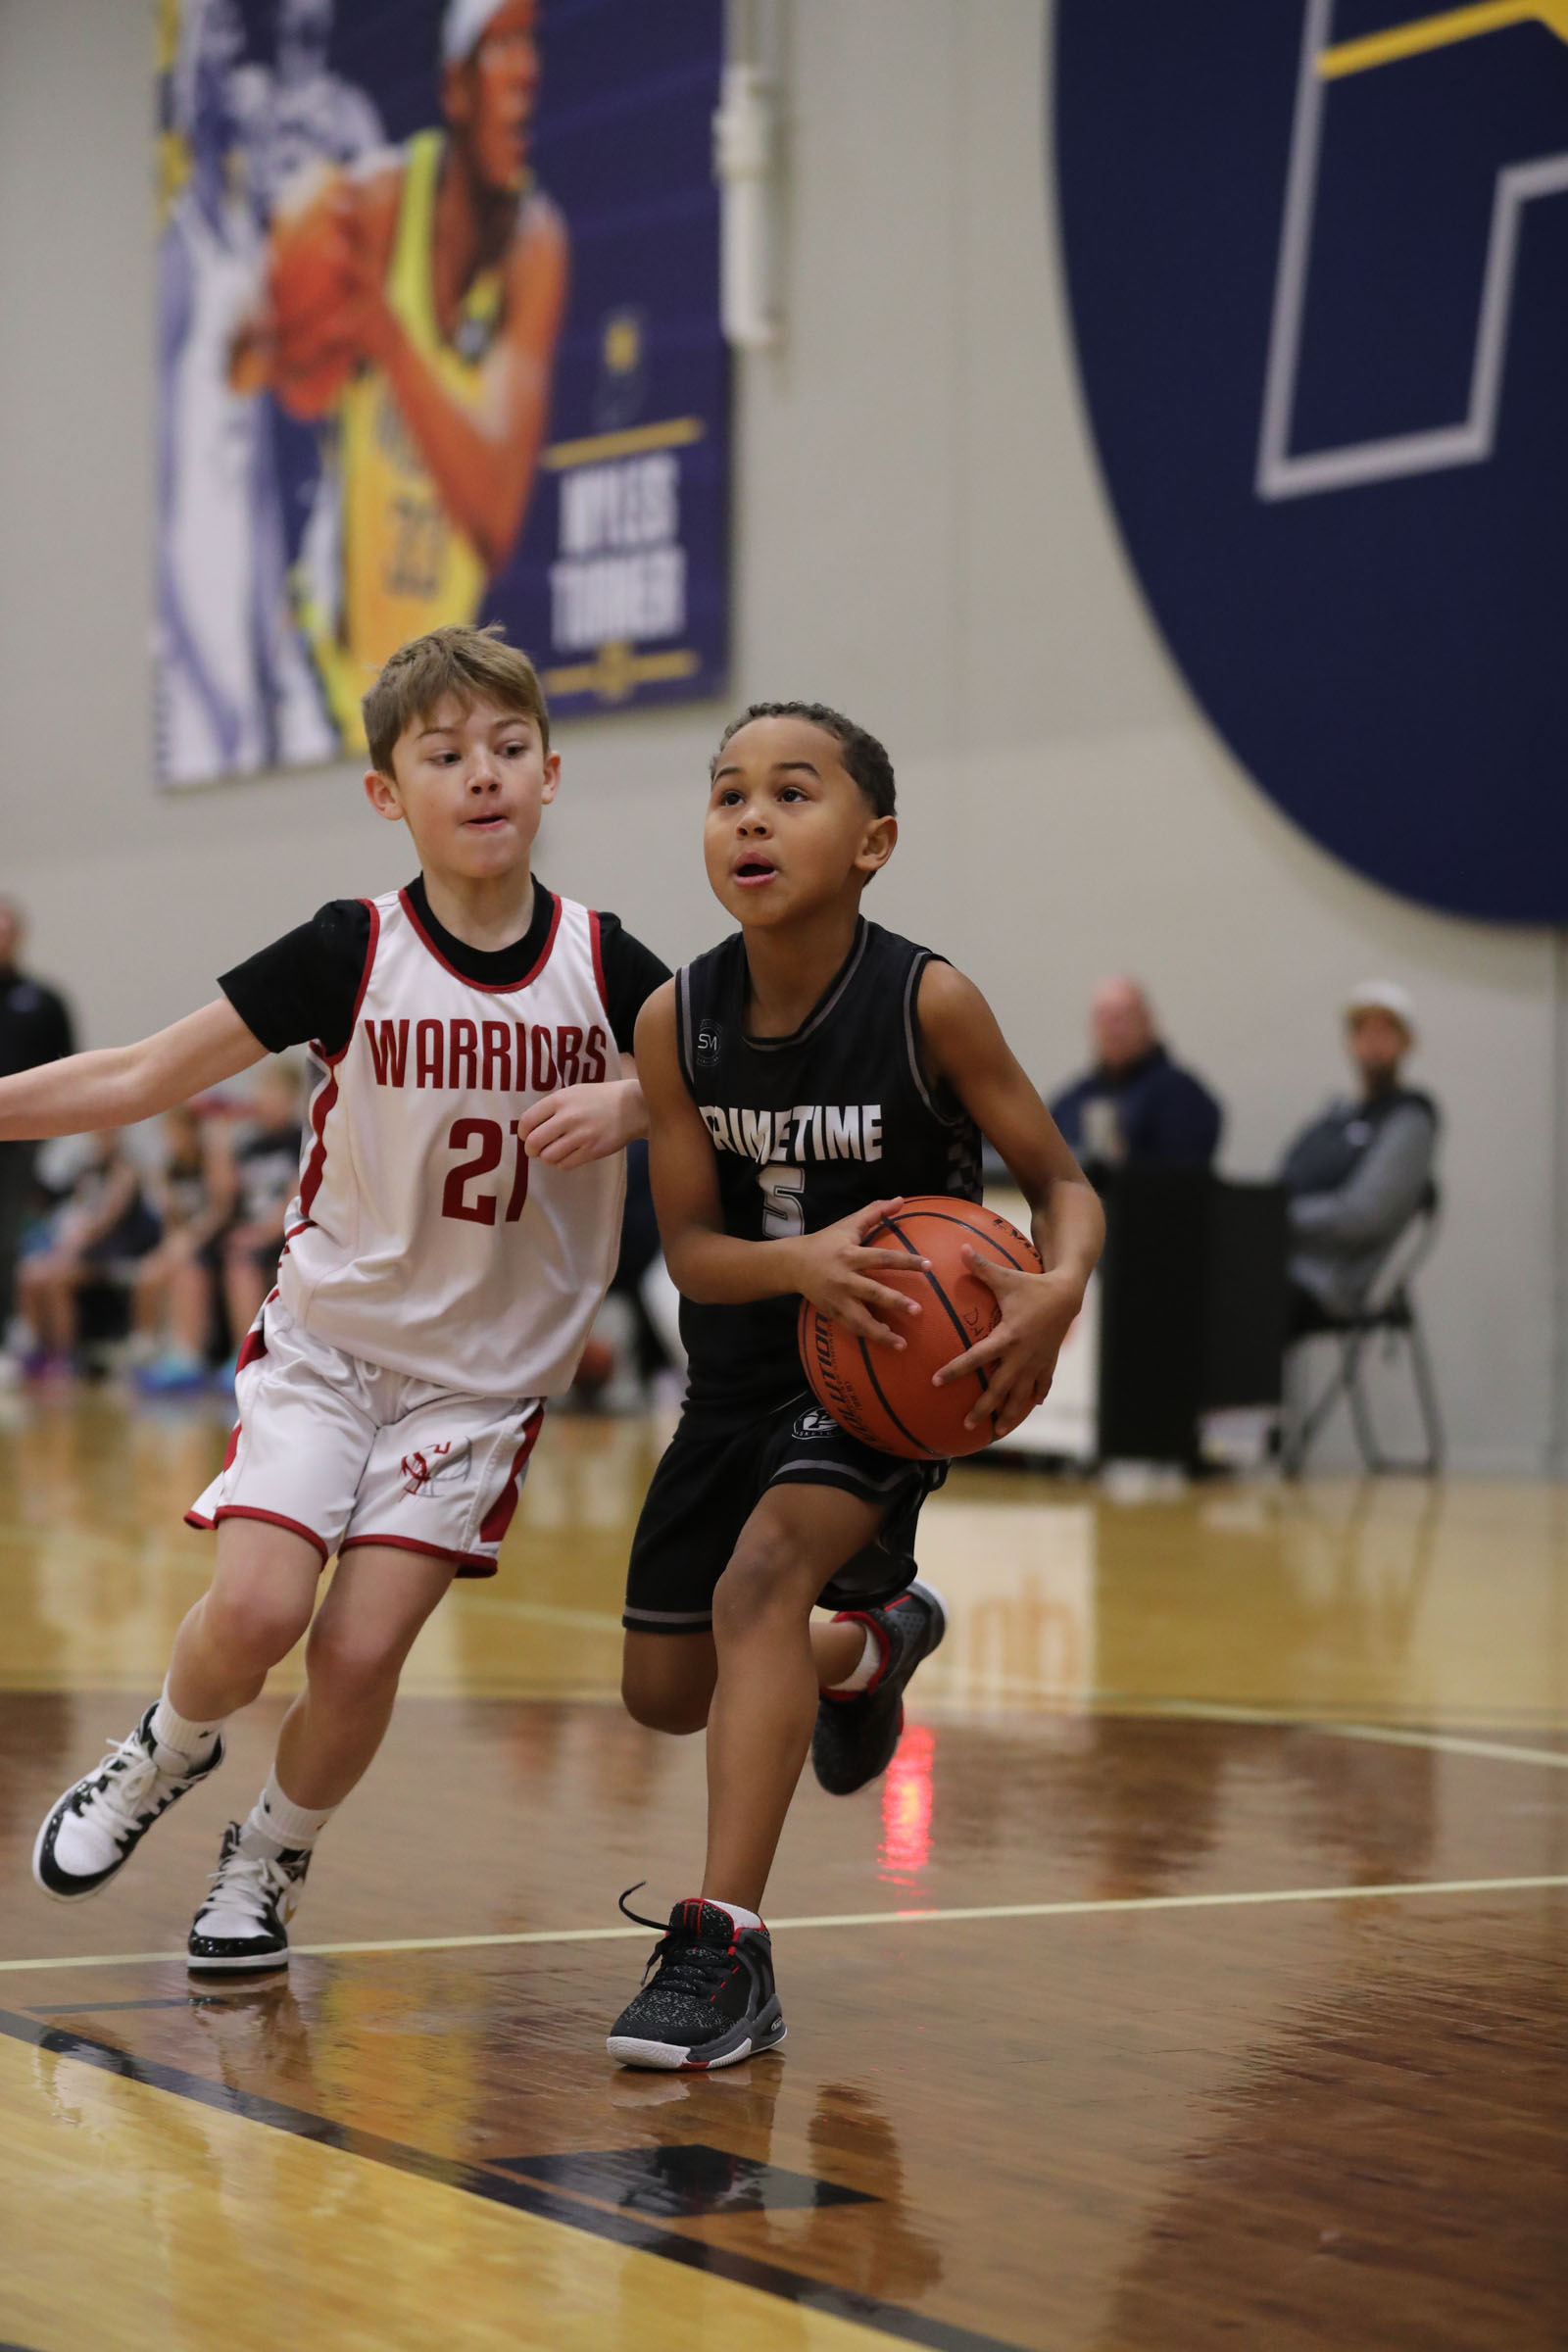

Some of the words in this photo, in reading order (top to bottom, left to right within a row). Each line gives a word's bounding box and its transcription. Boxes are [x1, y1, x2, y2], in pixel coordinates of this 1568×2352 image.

[365, 1018, 608, 1092] WARRIORS
[442, 1117, 529, 1226] 21
[698, 1104, 883, 1165] RIMETIME
